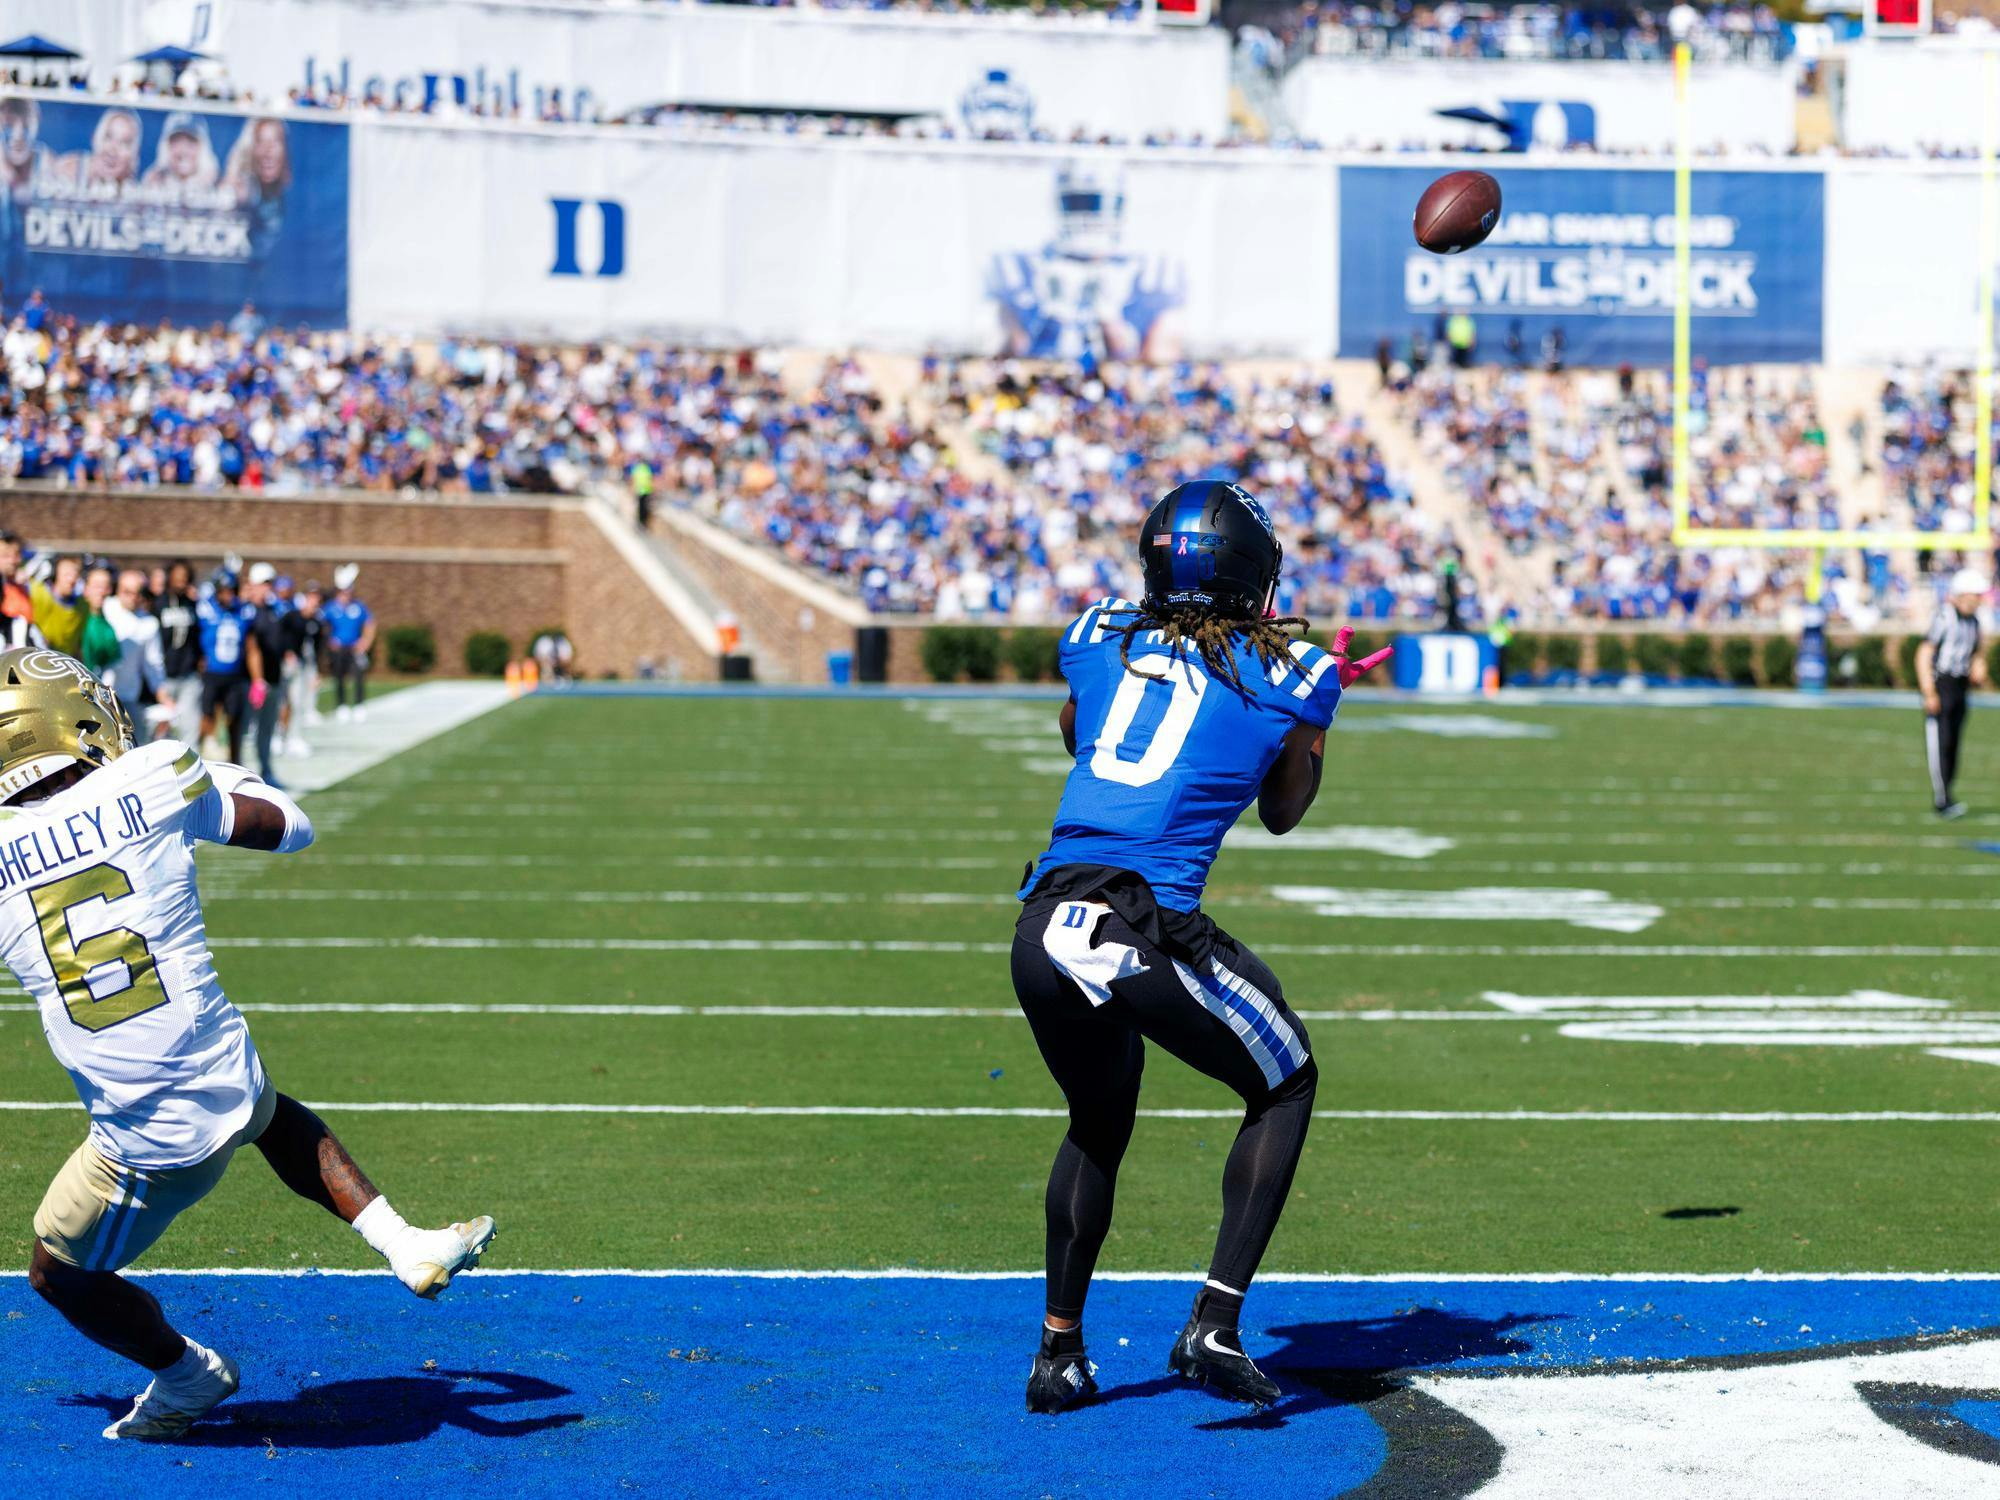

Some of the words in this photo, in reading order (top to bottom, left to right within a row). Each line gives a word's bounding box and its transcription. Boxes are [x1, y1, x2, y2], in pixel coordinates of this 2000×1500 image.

[25, 206, 141, 250] DEVILS
[164, 215, 251, 257] DECK
[550, 198, 624, 275] D
[1404, 257, 1585, 306] DEVILS
[1624, 258, 1757, 309] DECK
[1090, 654, 1208, 787] 0
[117, 792, 149, 840] JR
[1062, 905, 1088, 928] D
[28, 861, 171, 1032] 6
